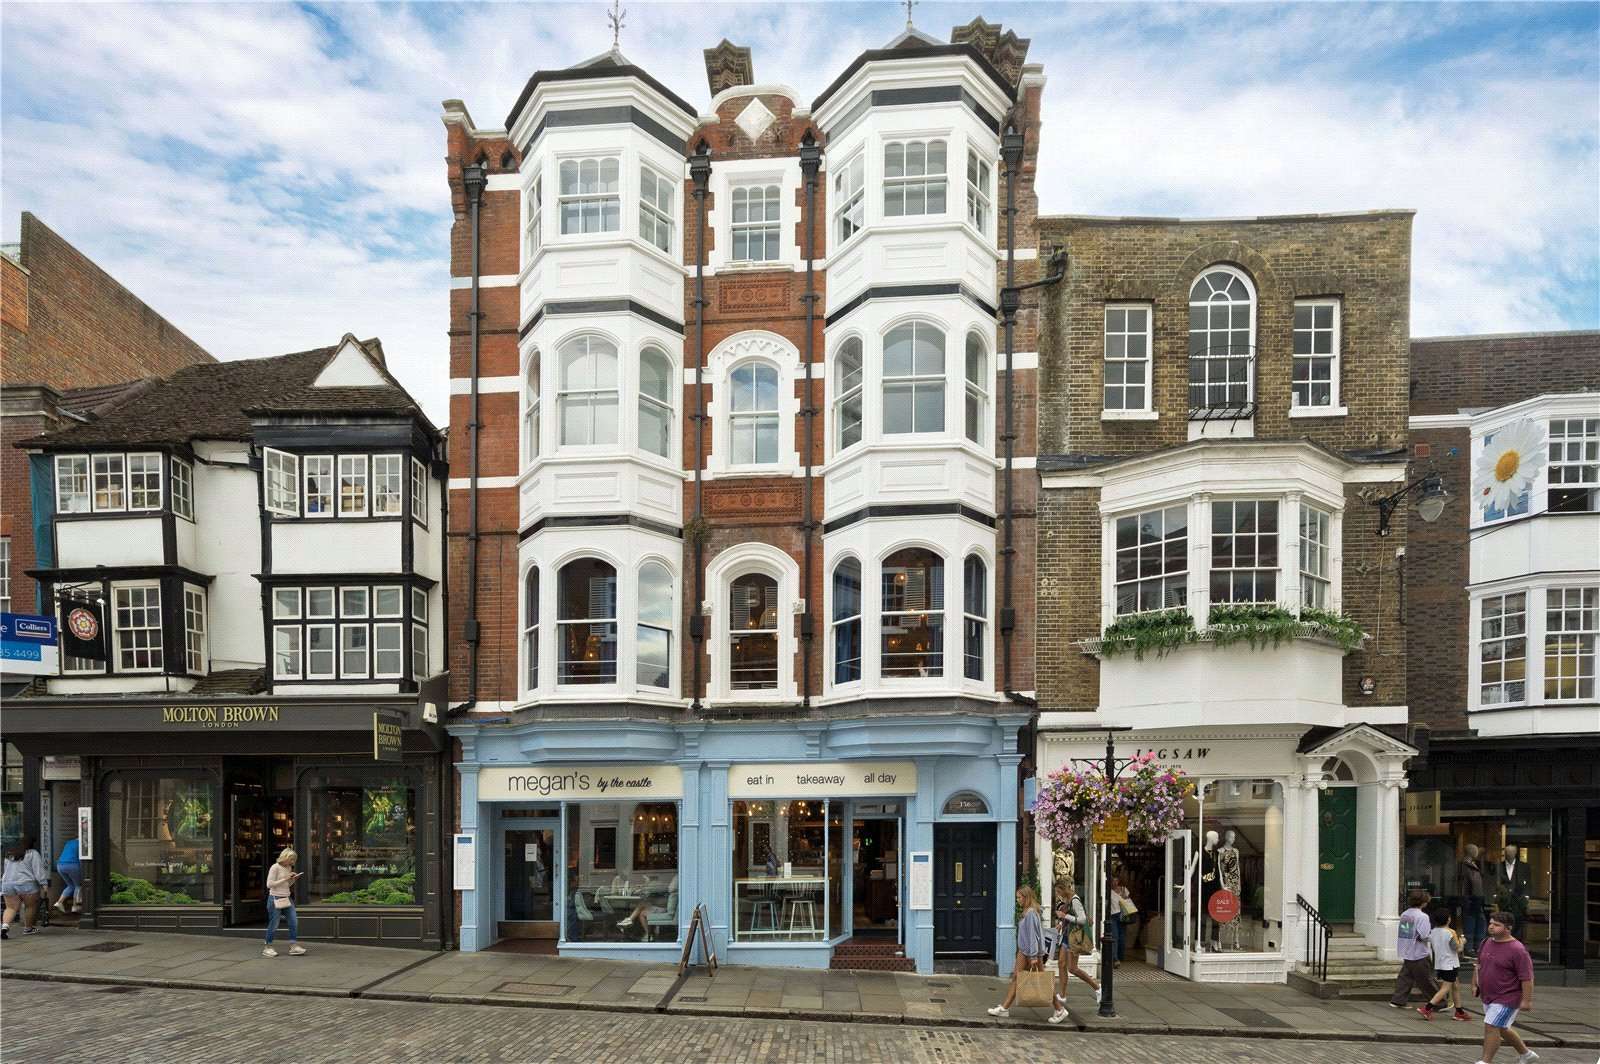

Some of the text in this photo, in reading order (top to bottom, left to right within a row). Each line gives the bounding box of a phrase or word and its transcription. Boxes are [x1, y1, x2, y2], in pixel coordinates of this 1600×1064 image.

[19, 622, 48, 632] Colliers
[162, 706, 279, 722] MOLTON BROWN
[378, 722, 401, 735] MOLTON
[378, 734, 402, 747] BROWN
[508, 771, 652, 796] megan's by the castle
[746, 773, 897, 786] eat in takeaway all day
